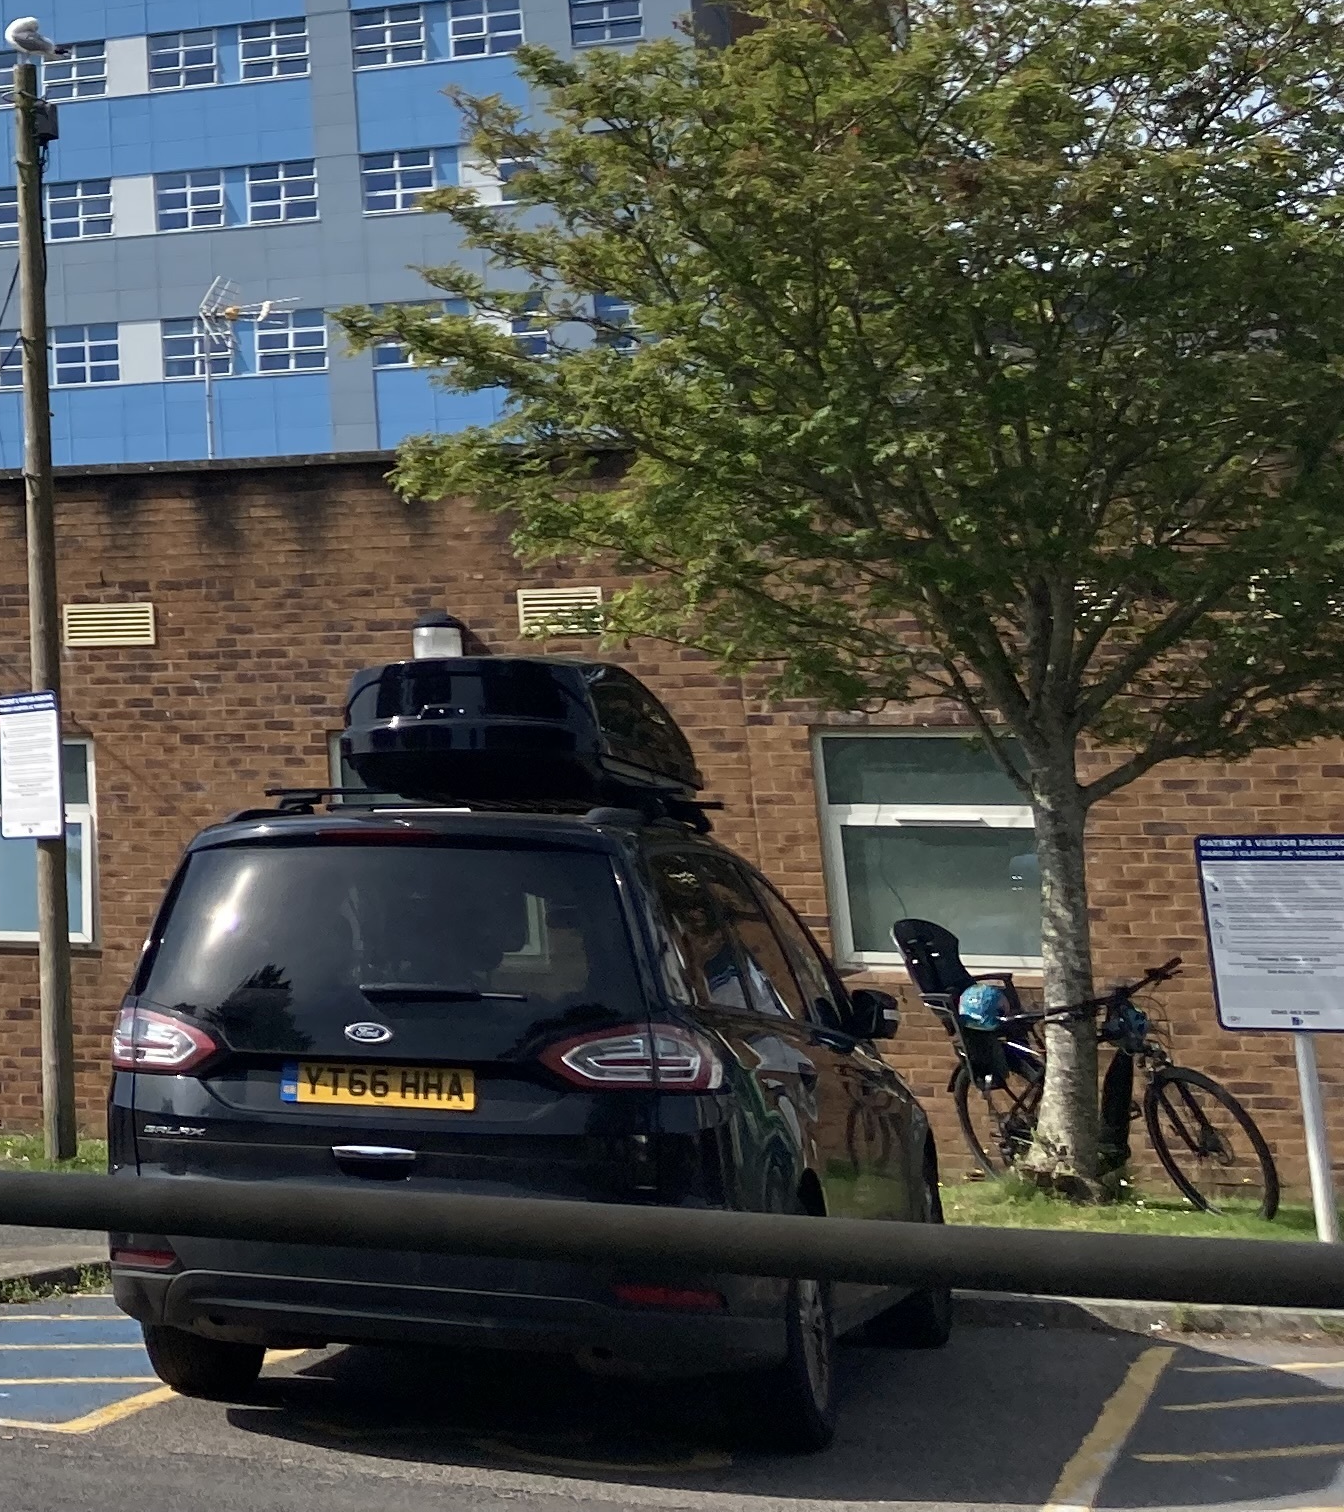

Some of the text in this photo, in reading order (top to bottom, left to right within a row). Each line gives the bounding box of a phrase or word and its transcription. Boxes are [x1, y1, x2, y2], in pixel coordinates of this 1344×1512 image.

[1199, 839, 1243, 847] PATIENT
[1254, 839, 1297, 847] VISITOR
[355, 1025, 380, 1038] Ford
[304, 1066, 465, 1102] YT66 HHA
